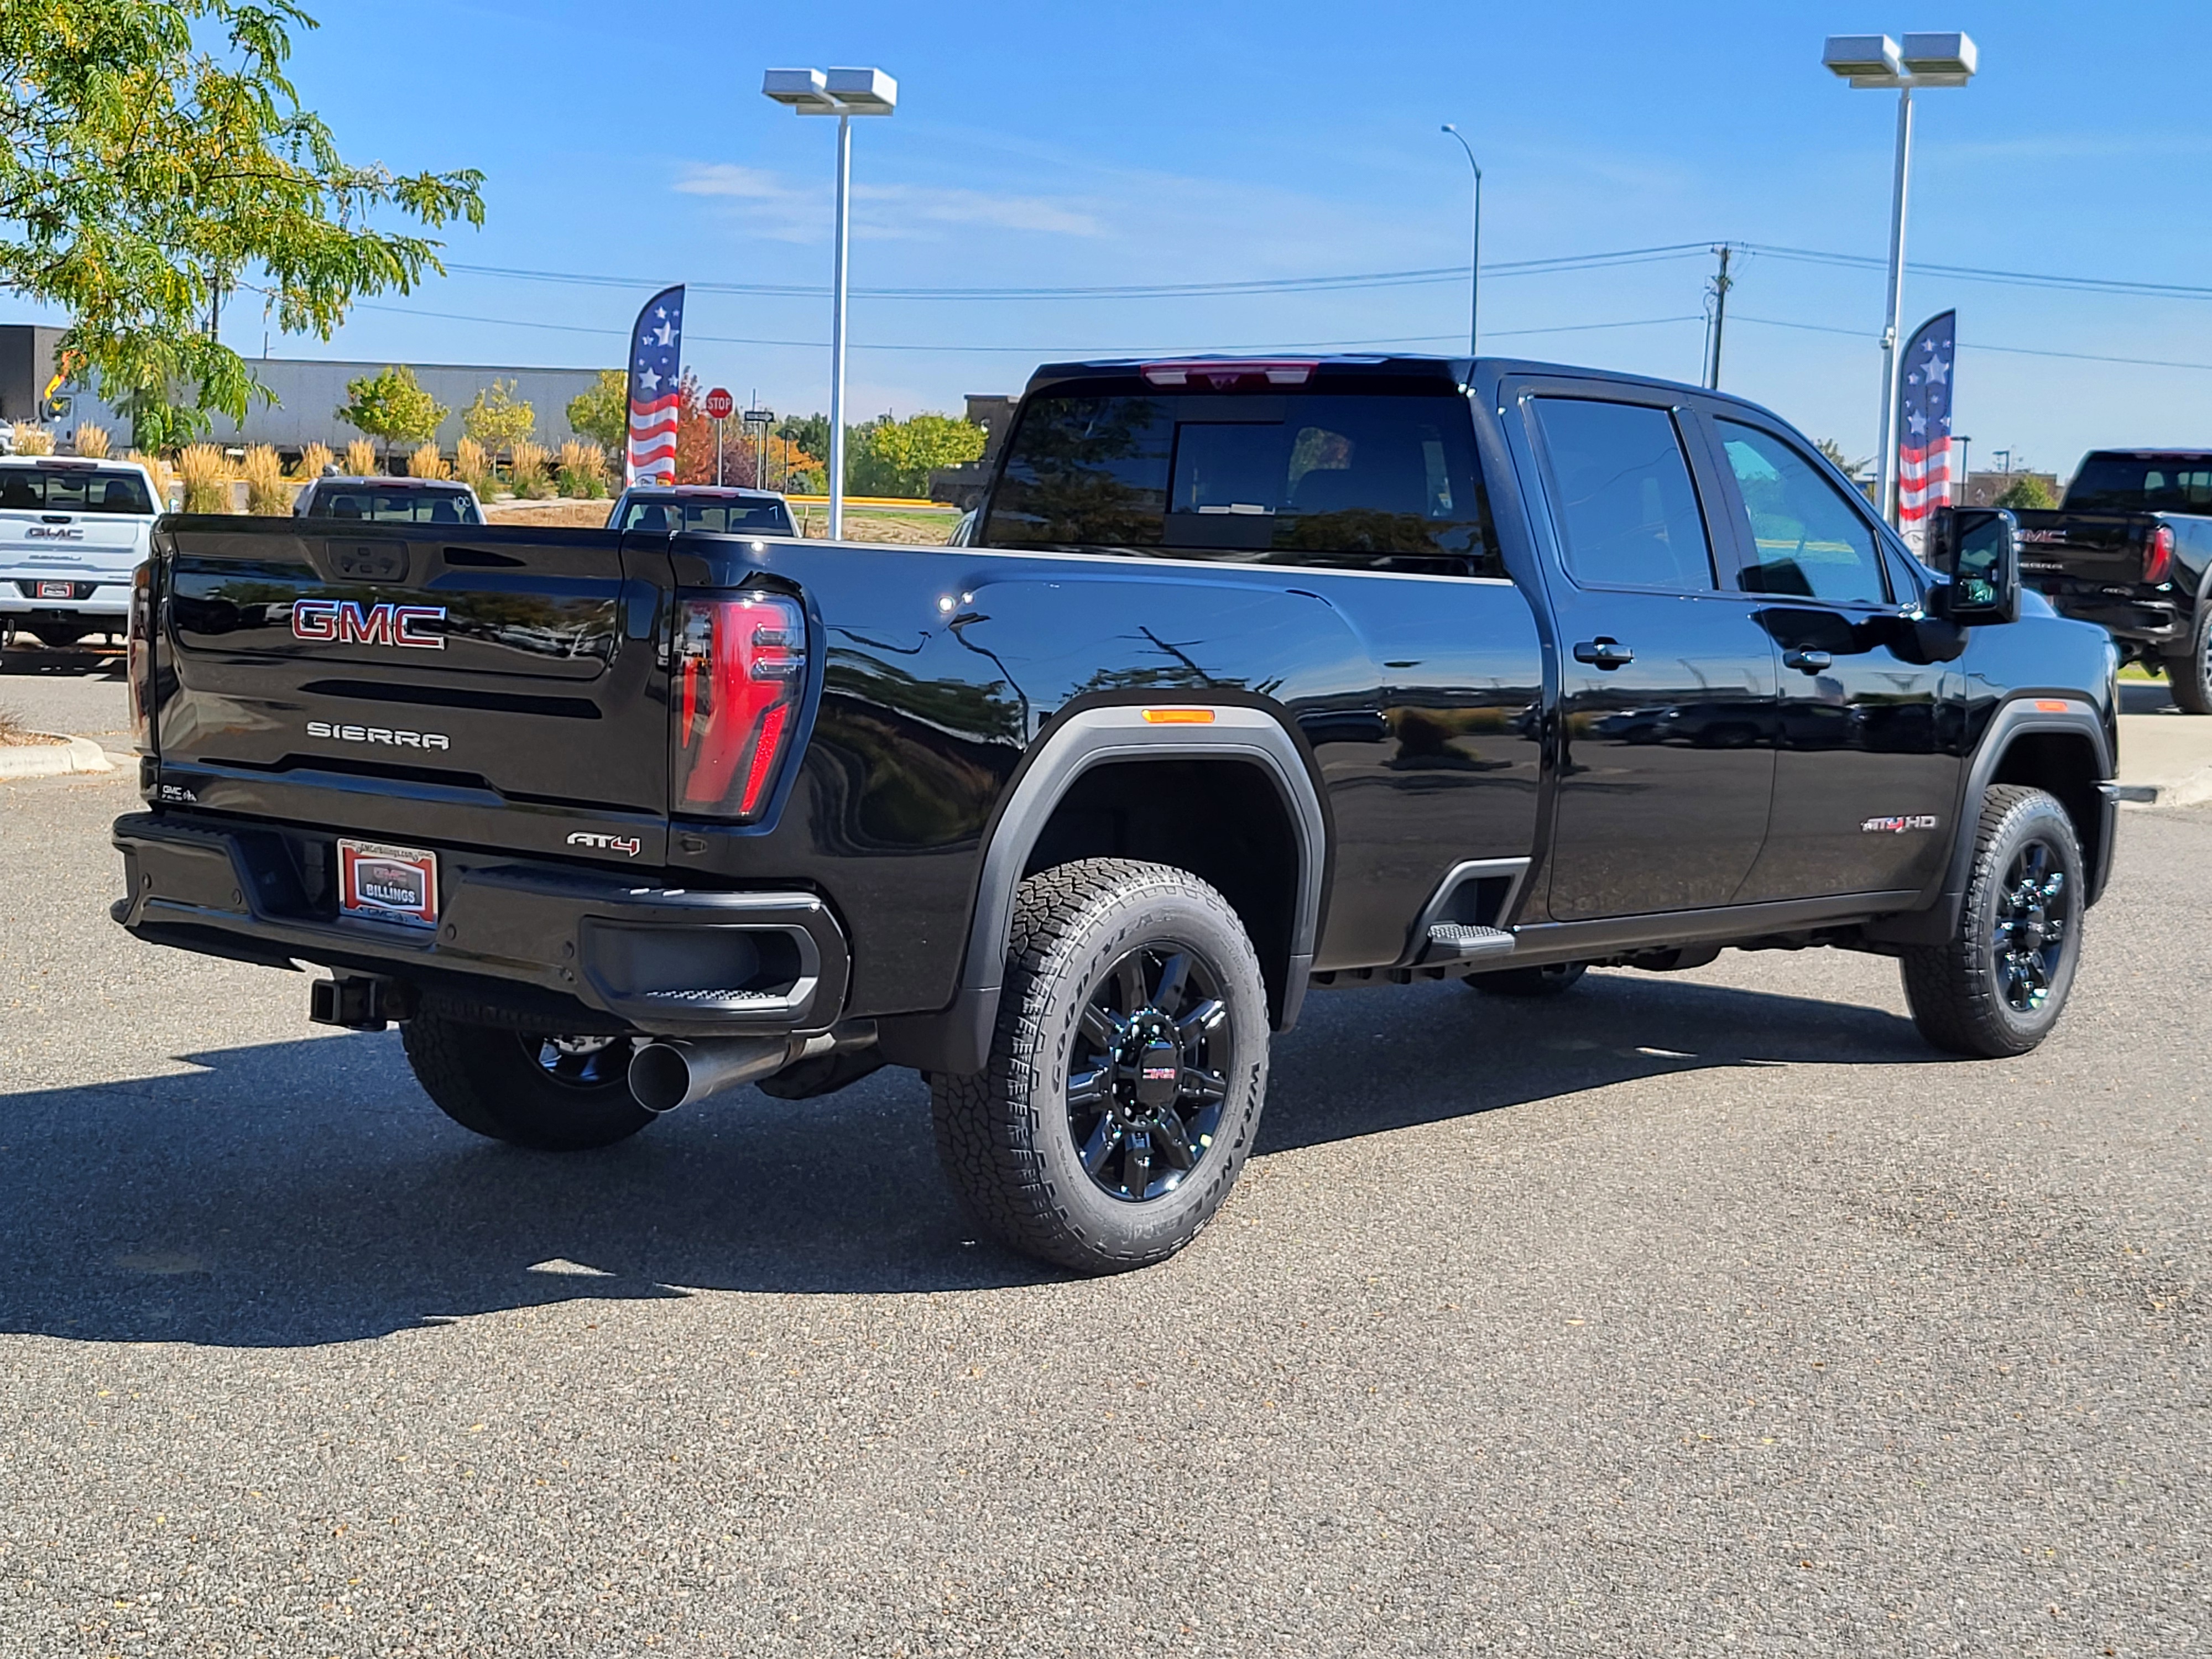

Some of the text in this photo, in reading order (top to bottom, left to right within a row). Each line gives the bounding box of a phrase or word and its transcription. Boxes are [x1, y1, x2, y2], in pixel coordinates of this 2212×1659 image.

[708, 397, 731, 410] STOP
[27, 527, 84, 540] GMC
[293, 599, 446, 650] GMC
[307, 722, 450, 750] SIERRA
[567, 832, 640, 857] AT4
[373, 867, 407, 881] GMC
[366, 881, 415, 904] BILLINGS
